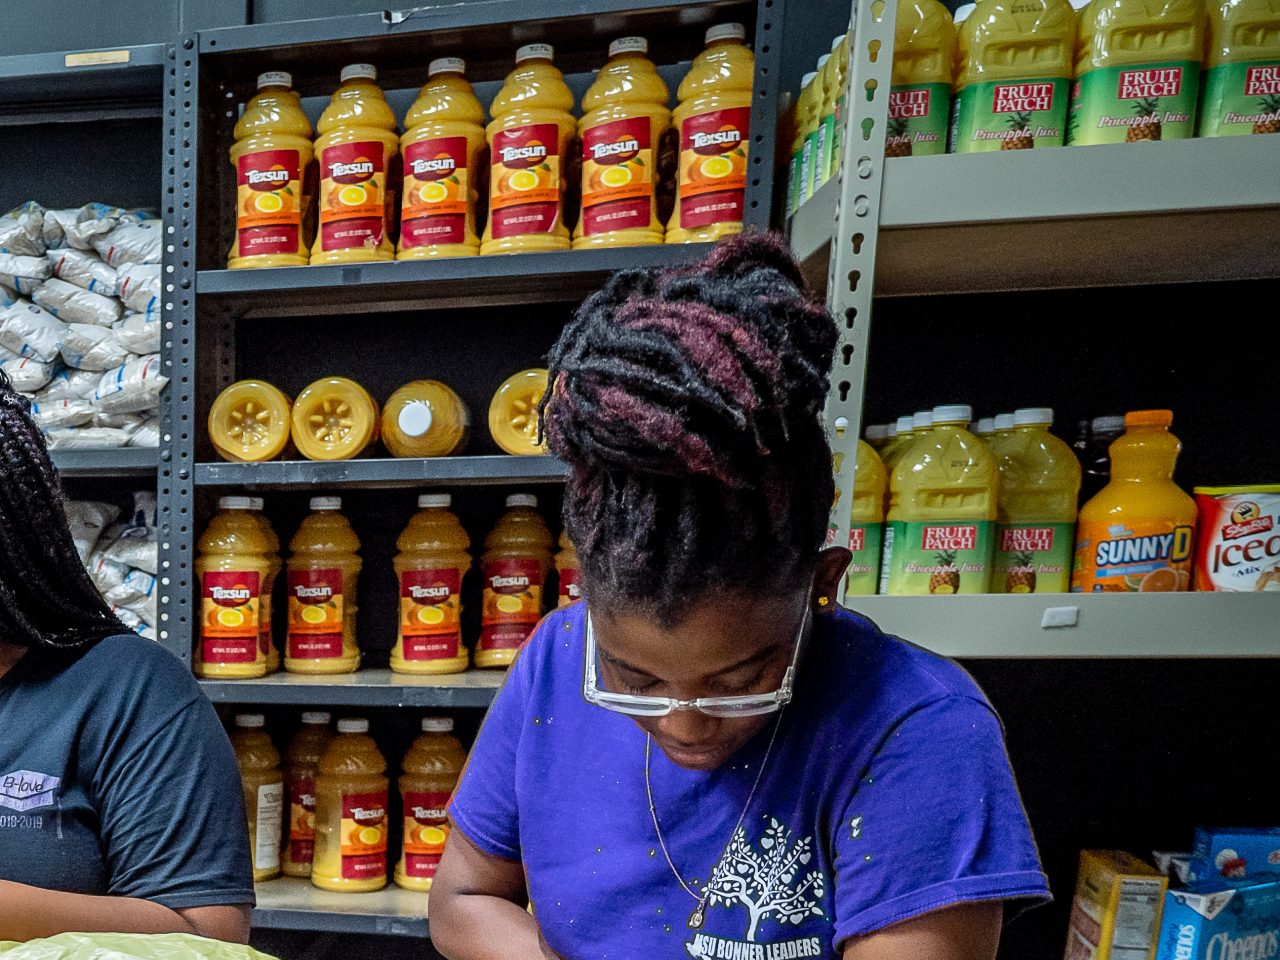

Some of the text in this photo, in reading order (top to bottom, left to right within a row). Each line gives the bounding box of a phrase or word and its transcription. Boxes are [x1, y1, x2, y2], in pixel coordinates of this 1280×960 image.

[1124, 69, 1178, 86] FRUIT
[1251, 68, 1280, 82] FRU
[999, 84, 1051, 100] FRUIT
[1121, 83, 1176, 99] PATCH
[1248, 81, 1280, 95] PAT
[889, 90, 927, 105] RUIT
[996, 97, 1049, 112] PATCH
[888, 104, 925, 117] ATCH
[1098, 112, 1190, 128] Pineapple Juice
[689, 129, 741, 147] Texsun
[912, 130, 939, 144] Juice
[974, 127, 1060, 141] Pineapple Juice
[499, 145, 546, 161] Texsun
[590, 140, 638, 158] Texsun
[328, 162, 373, 176] Texsun
[410, 158, 455, 173] Texsun
[245, 170, 289, 183] Texsun
[926, 527, 974, 539] FRUIT
[1004, 529, 1052, 541] FRUIT
[925, 537, 973, 549] PATCH
[1002, 539, 1050, 551] PATCH
[905, 563, 984, 574] Pineapple Juice
[1037, 564, 1063, 574] Juice
[489, 574, 530, 588] Texsun
[209, 586, 250, 601] Texsun
[294, 586, 332, 598] Texsun
[408, 585, 450, 598] Texsun
[411, 806, 448, 819] Texsu
[693, 933, 717, 956] MSU
